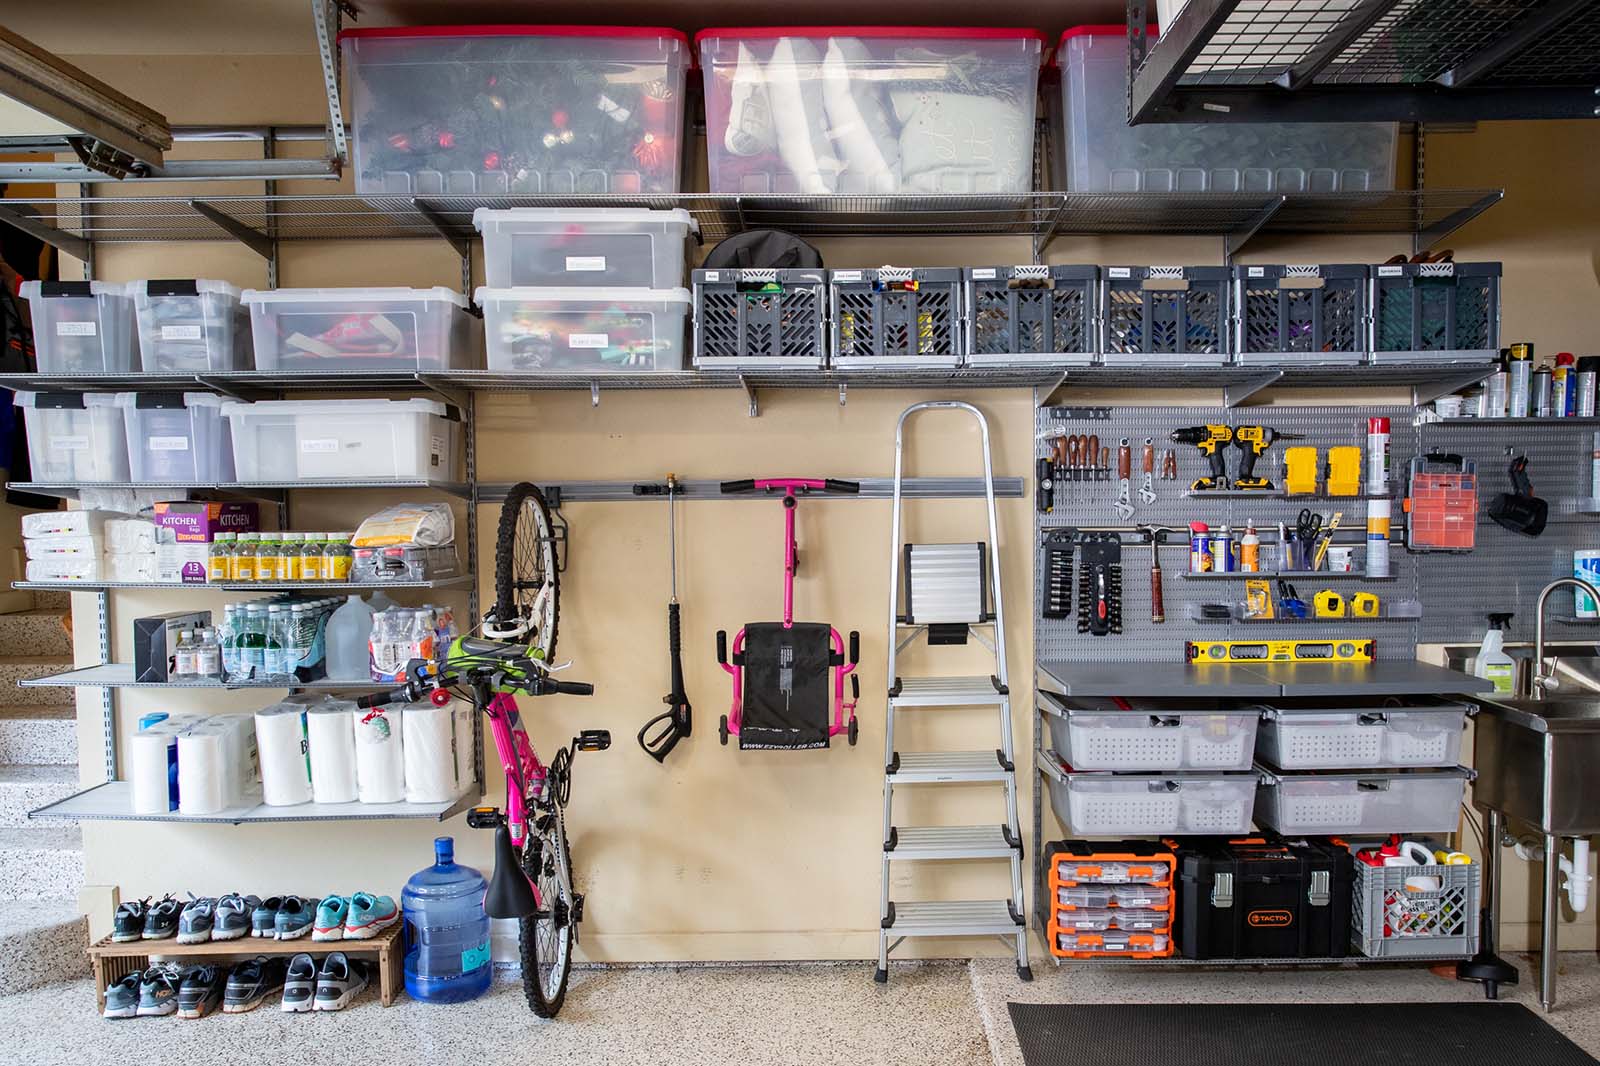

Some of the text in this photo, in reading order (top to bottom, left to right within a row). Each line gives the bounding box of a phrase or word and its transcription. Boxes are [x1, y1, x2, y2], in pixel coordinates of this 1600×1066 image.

[162, 517, 197, 525] KITCHEN
[219, 514, 250, 526] KITCHEN
[188, 562, 199, 572] 13
